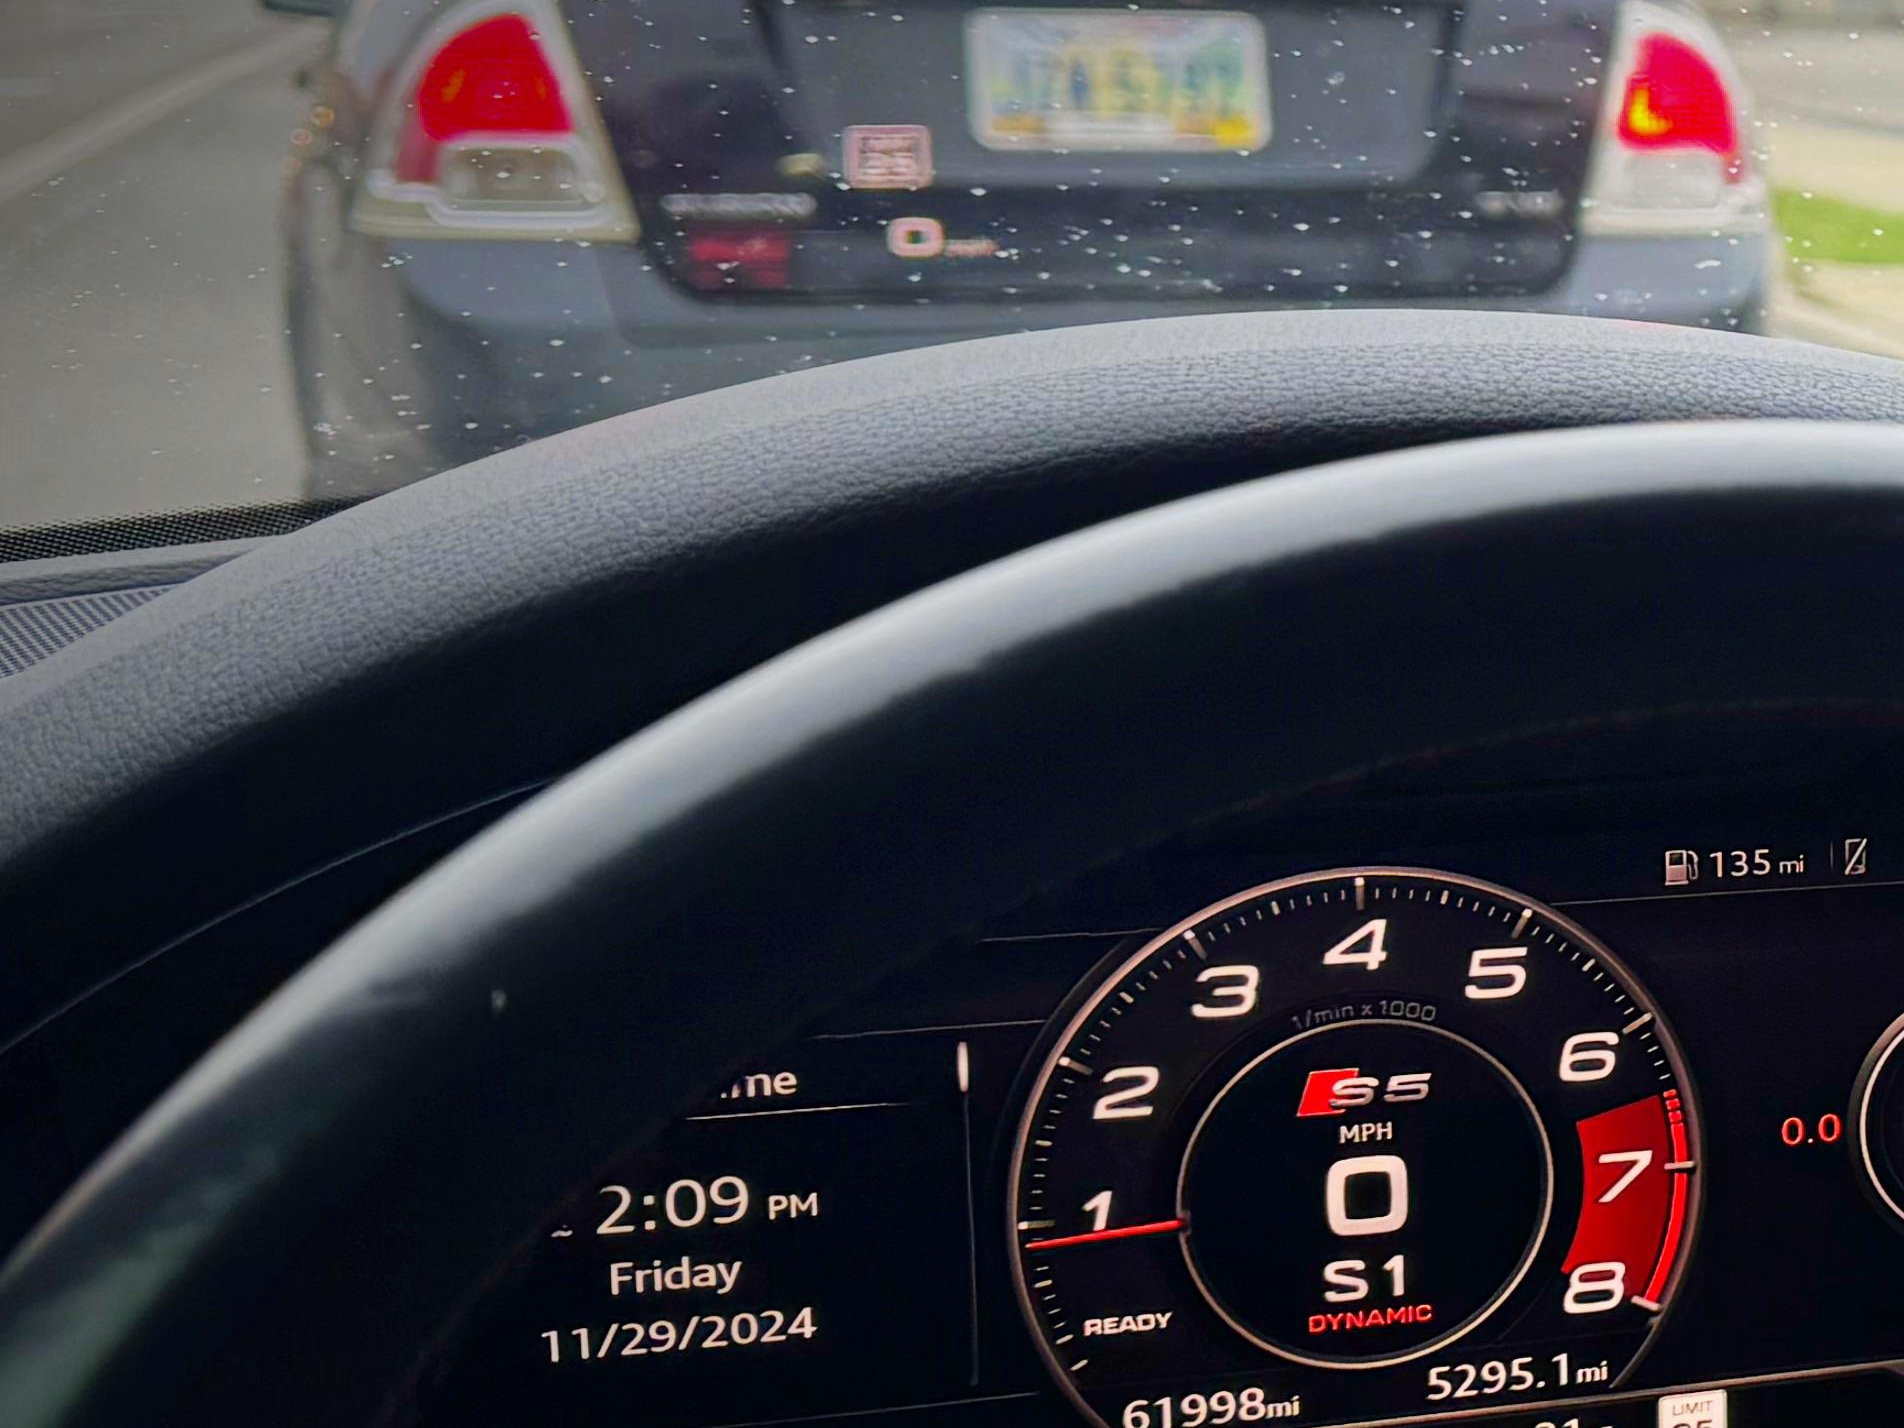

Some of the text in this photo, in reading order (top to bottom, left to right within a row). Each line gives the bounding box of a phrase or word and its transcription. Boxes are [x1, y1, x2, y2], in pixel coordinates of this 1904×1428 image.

[1709, 848, 1804, 878] 135 mi
[1322, 918, 1388, 971] 4
[1191, 964, 1260, 1018] 3
[1464, 946, 1528, 1000] 5
[1379, 999, 1437, 1022] 1000
[1558, 1031, 1620, 1082] 6
[1092, 1066, 1160, 1120] 2
[1339, 1121, 1393, 1144] MPH
[1781, 1113, 1842, 1146] 0.0
[1325, 1154, 1409, 1237] 0
[1597, 1149, 1653, 1203] 7
[596, 1175, 819, 1235] 2:09 PM
[1082, 1189, 1113, 1232] 1
[610, 1255, 742, 1296] Friday
[1563, 1261, 1626, 1314] 8
[541, 1306, 818, 1363] 11/29/2024
[1083, 1311, 1173, 1337] READY
[1308, 1304, 1433, 1333] DYNAMIC
[1671, 1400, 1713, 1416] LIMIT
